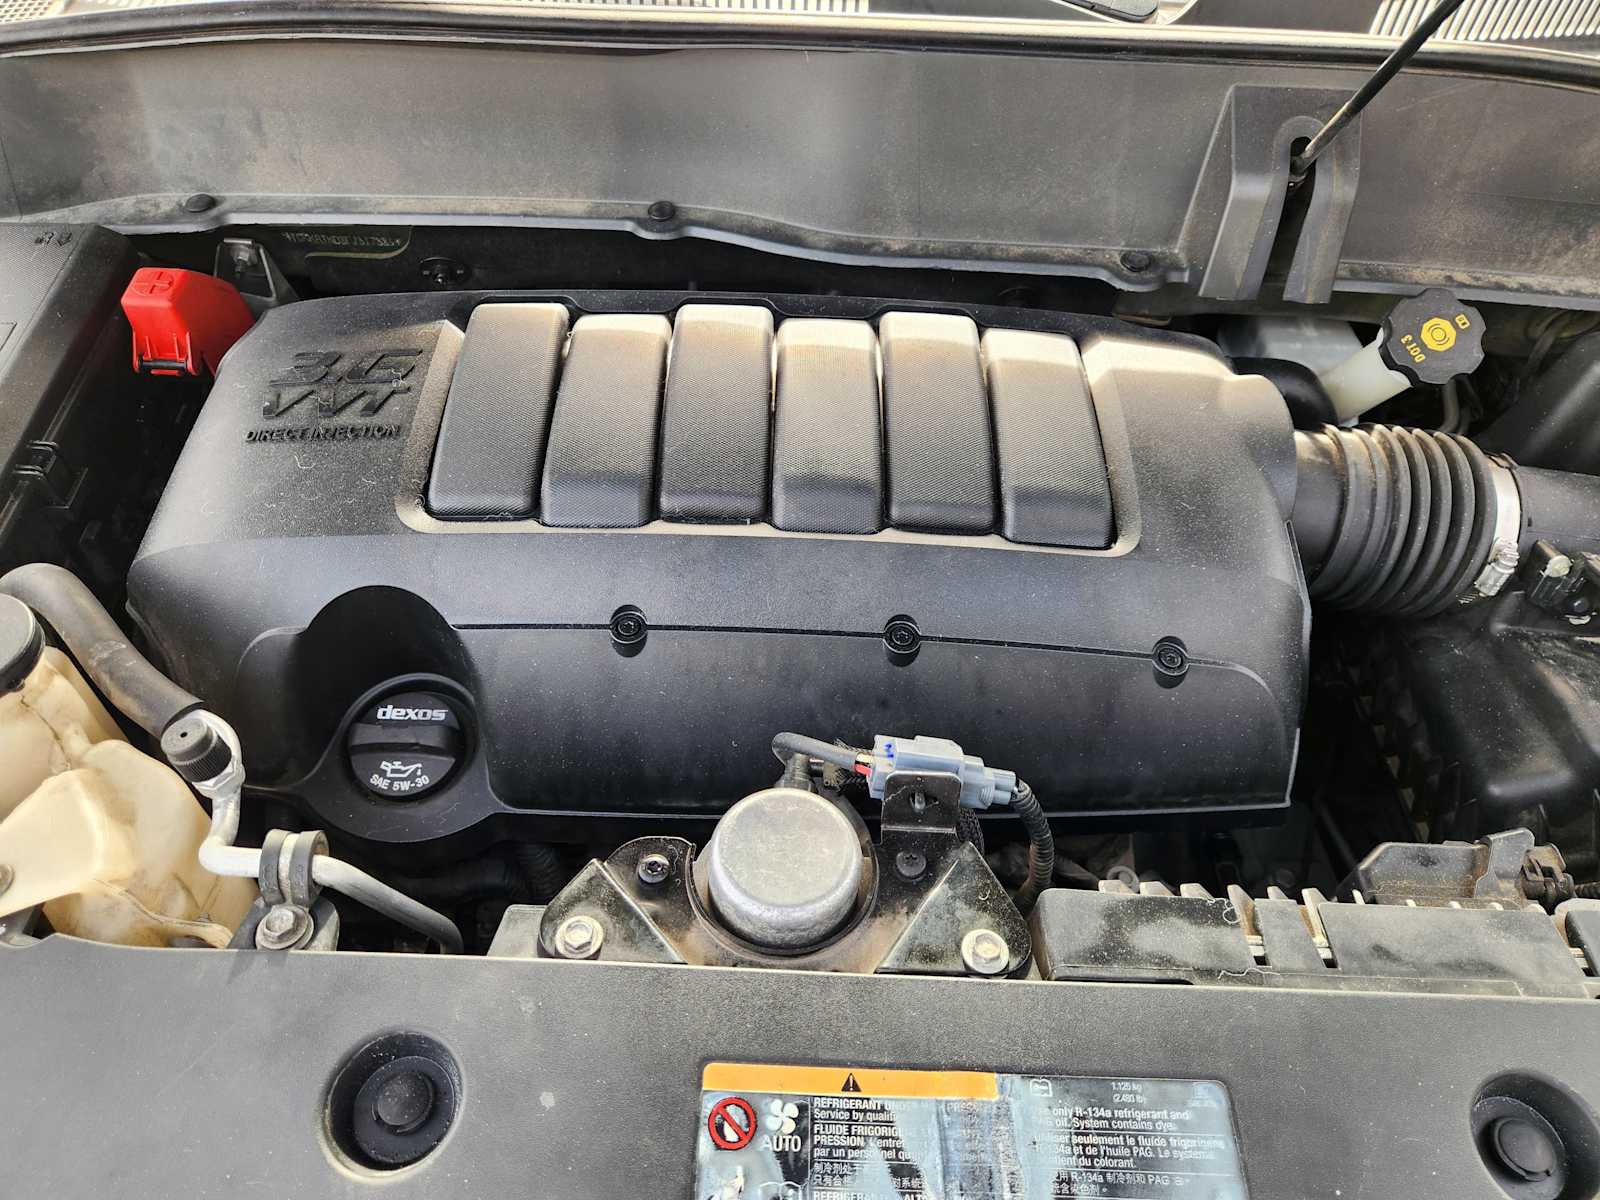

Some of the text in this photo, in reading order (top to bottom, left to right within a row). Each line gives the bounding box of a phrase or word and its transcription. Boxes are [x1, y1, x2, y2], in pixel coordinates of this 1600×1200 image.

[246, 424, 401, 443] DIRECT INJECTION
[376, 705, 449, 721] dexos
[369, 774, 430, 791] SAE 5W-30
[813, 1097, 881, 1110] REFRIGERANT
[814, 1108, 850, 1120] Service
[852, 1110, 864, 1122] by
[1052, 1107, 1073, 1118] only
[1075, 1106, 1112, 1118] R-134a
[1114, 1108, 1168, 1120] refrigerant
[1073, 1117, 1109, 1129] System
[1112, 1119, 1153, 1130] contains
[813, 1124, 849, 1135] FLUIDE
[851, 1125, 899, 1137] FRIGORIG
[761, 1135, 802, 1152] AUTO
[1071, 1134, 1125, 1145] seulement
[1126, 1135, 1136, 1146] le
[1138, 1136, 1167, 1147] fluide
[813, 1148, 830, 1158] par
[832, 1149, 846, 1158] un
[1073, 1145, 1084, 1155] et
[1085, 1145, 1098, 1155] de
[1157, 1147, 1170, 1158] Le
[1078, 1155, 1091, 1166] du
[1093, 1156, 1137, 1168] colorant.
[1070, 1172, 1104, 1183] R-134a
[1148, 1174, 1170, 1185] PAG
